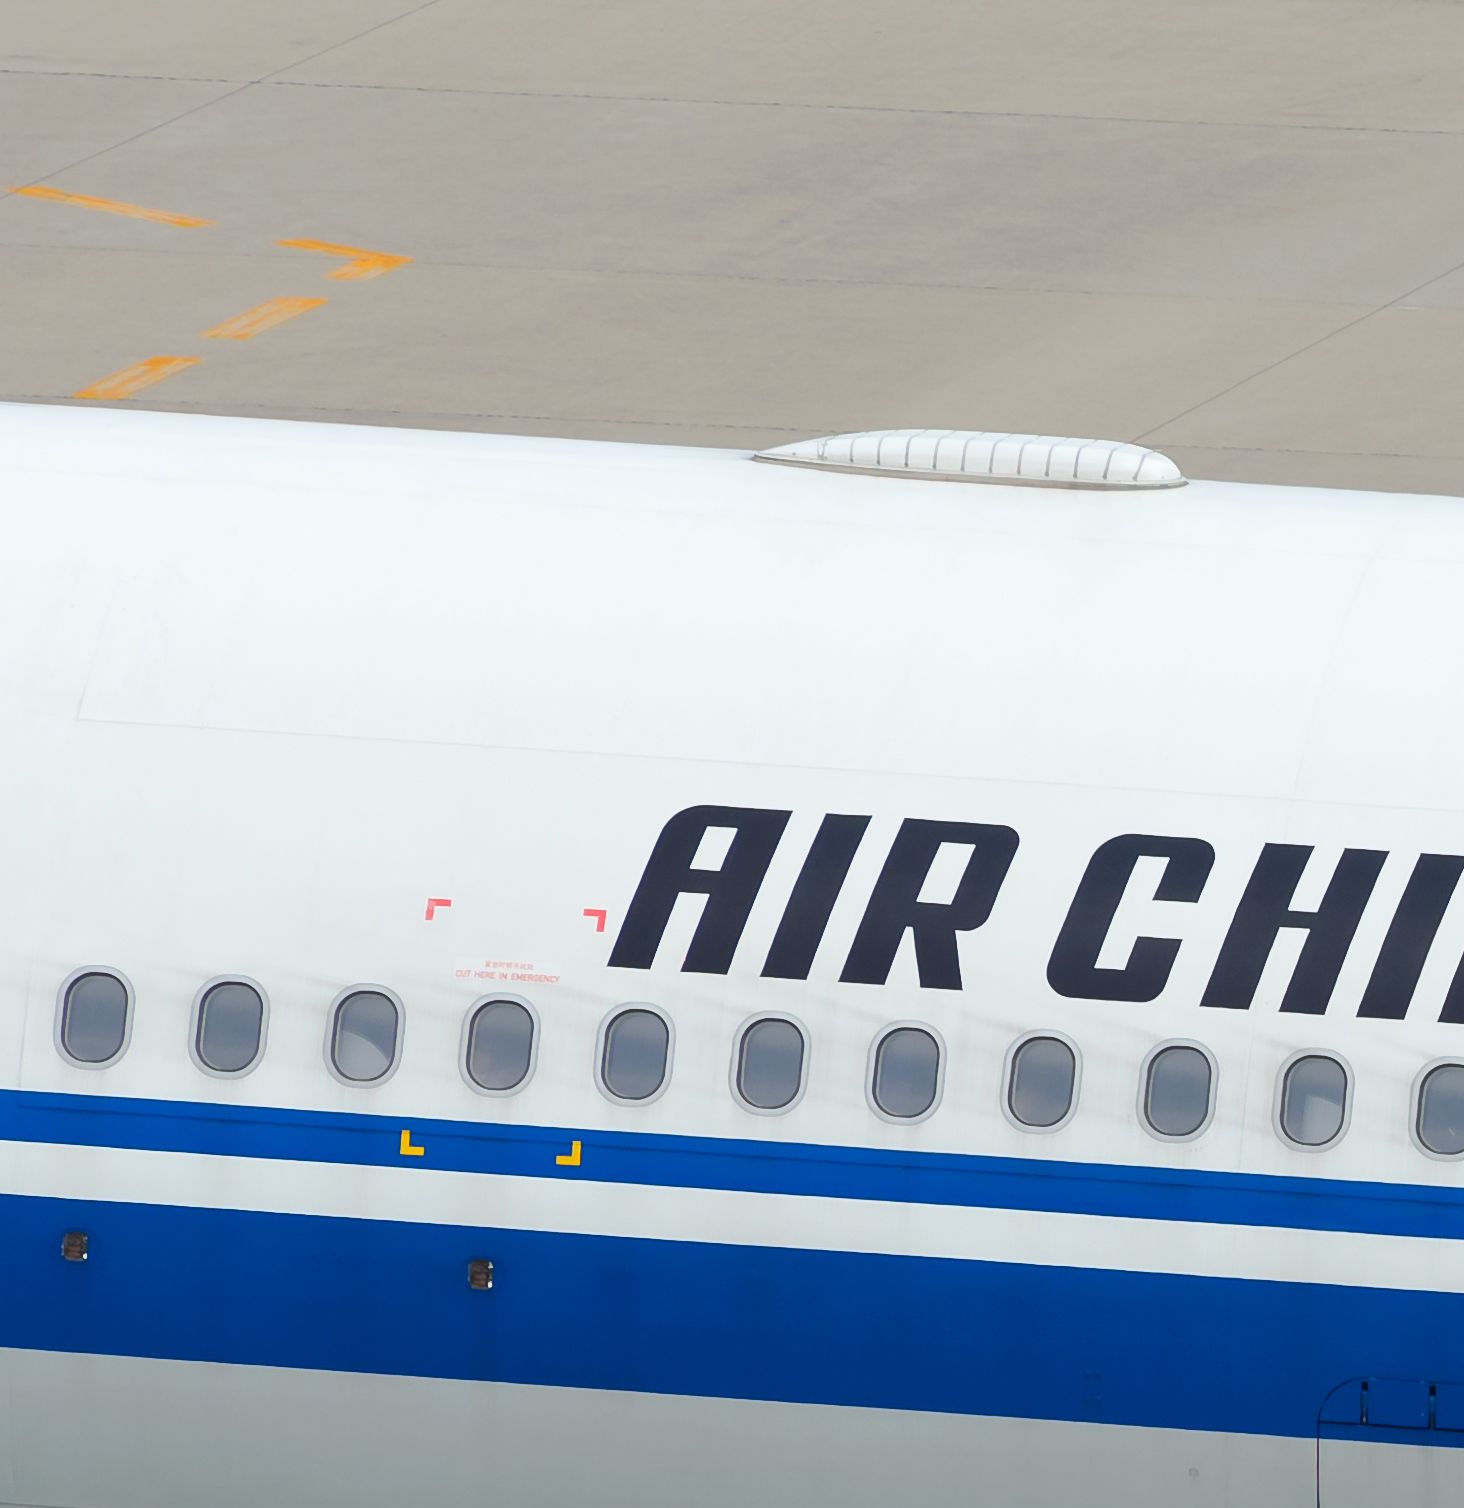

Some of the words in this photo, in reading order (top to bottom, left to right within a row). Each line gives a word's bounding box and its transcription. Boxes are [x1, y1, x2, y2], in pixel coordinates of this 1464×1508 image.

[608, 805, 1019, 990] AIR
[455, 969, 471, 978] CUT
[474, 970, 496, 980] HERE
[499, 972, 508, 980] IN
[511, 973, 560, 984] EMERGENCY
